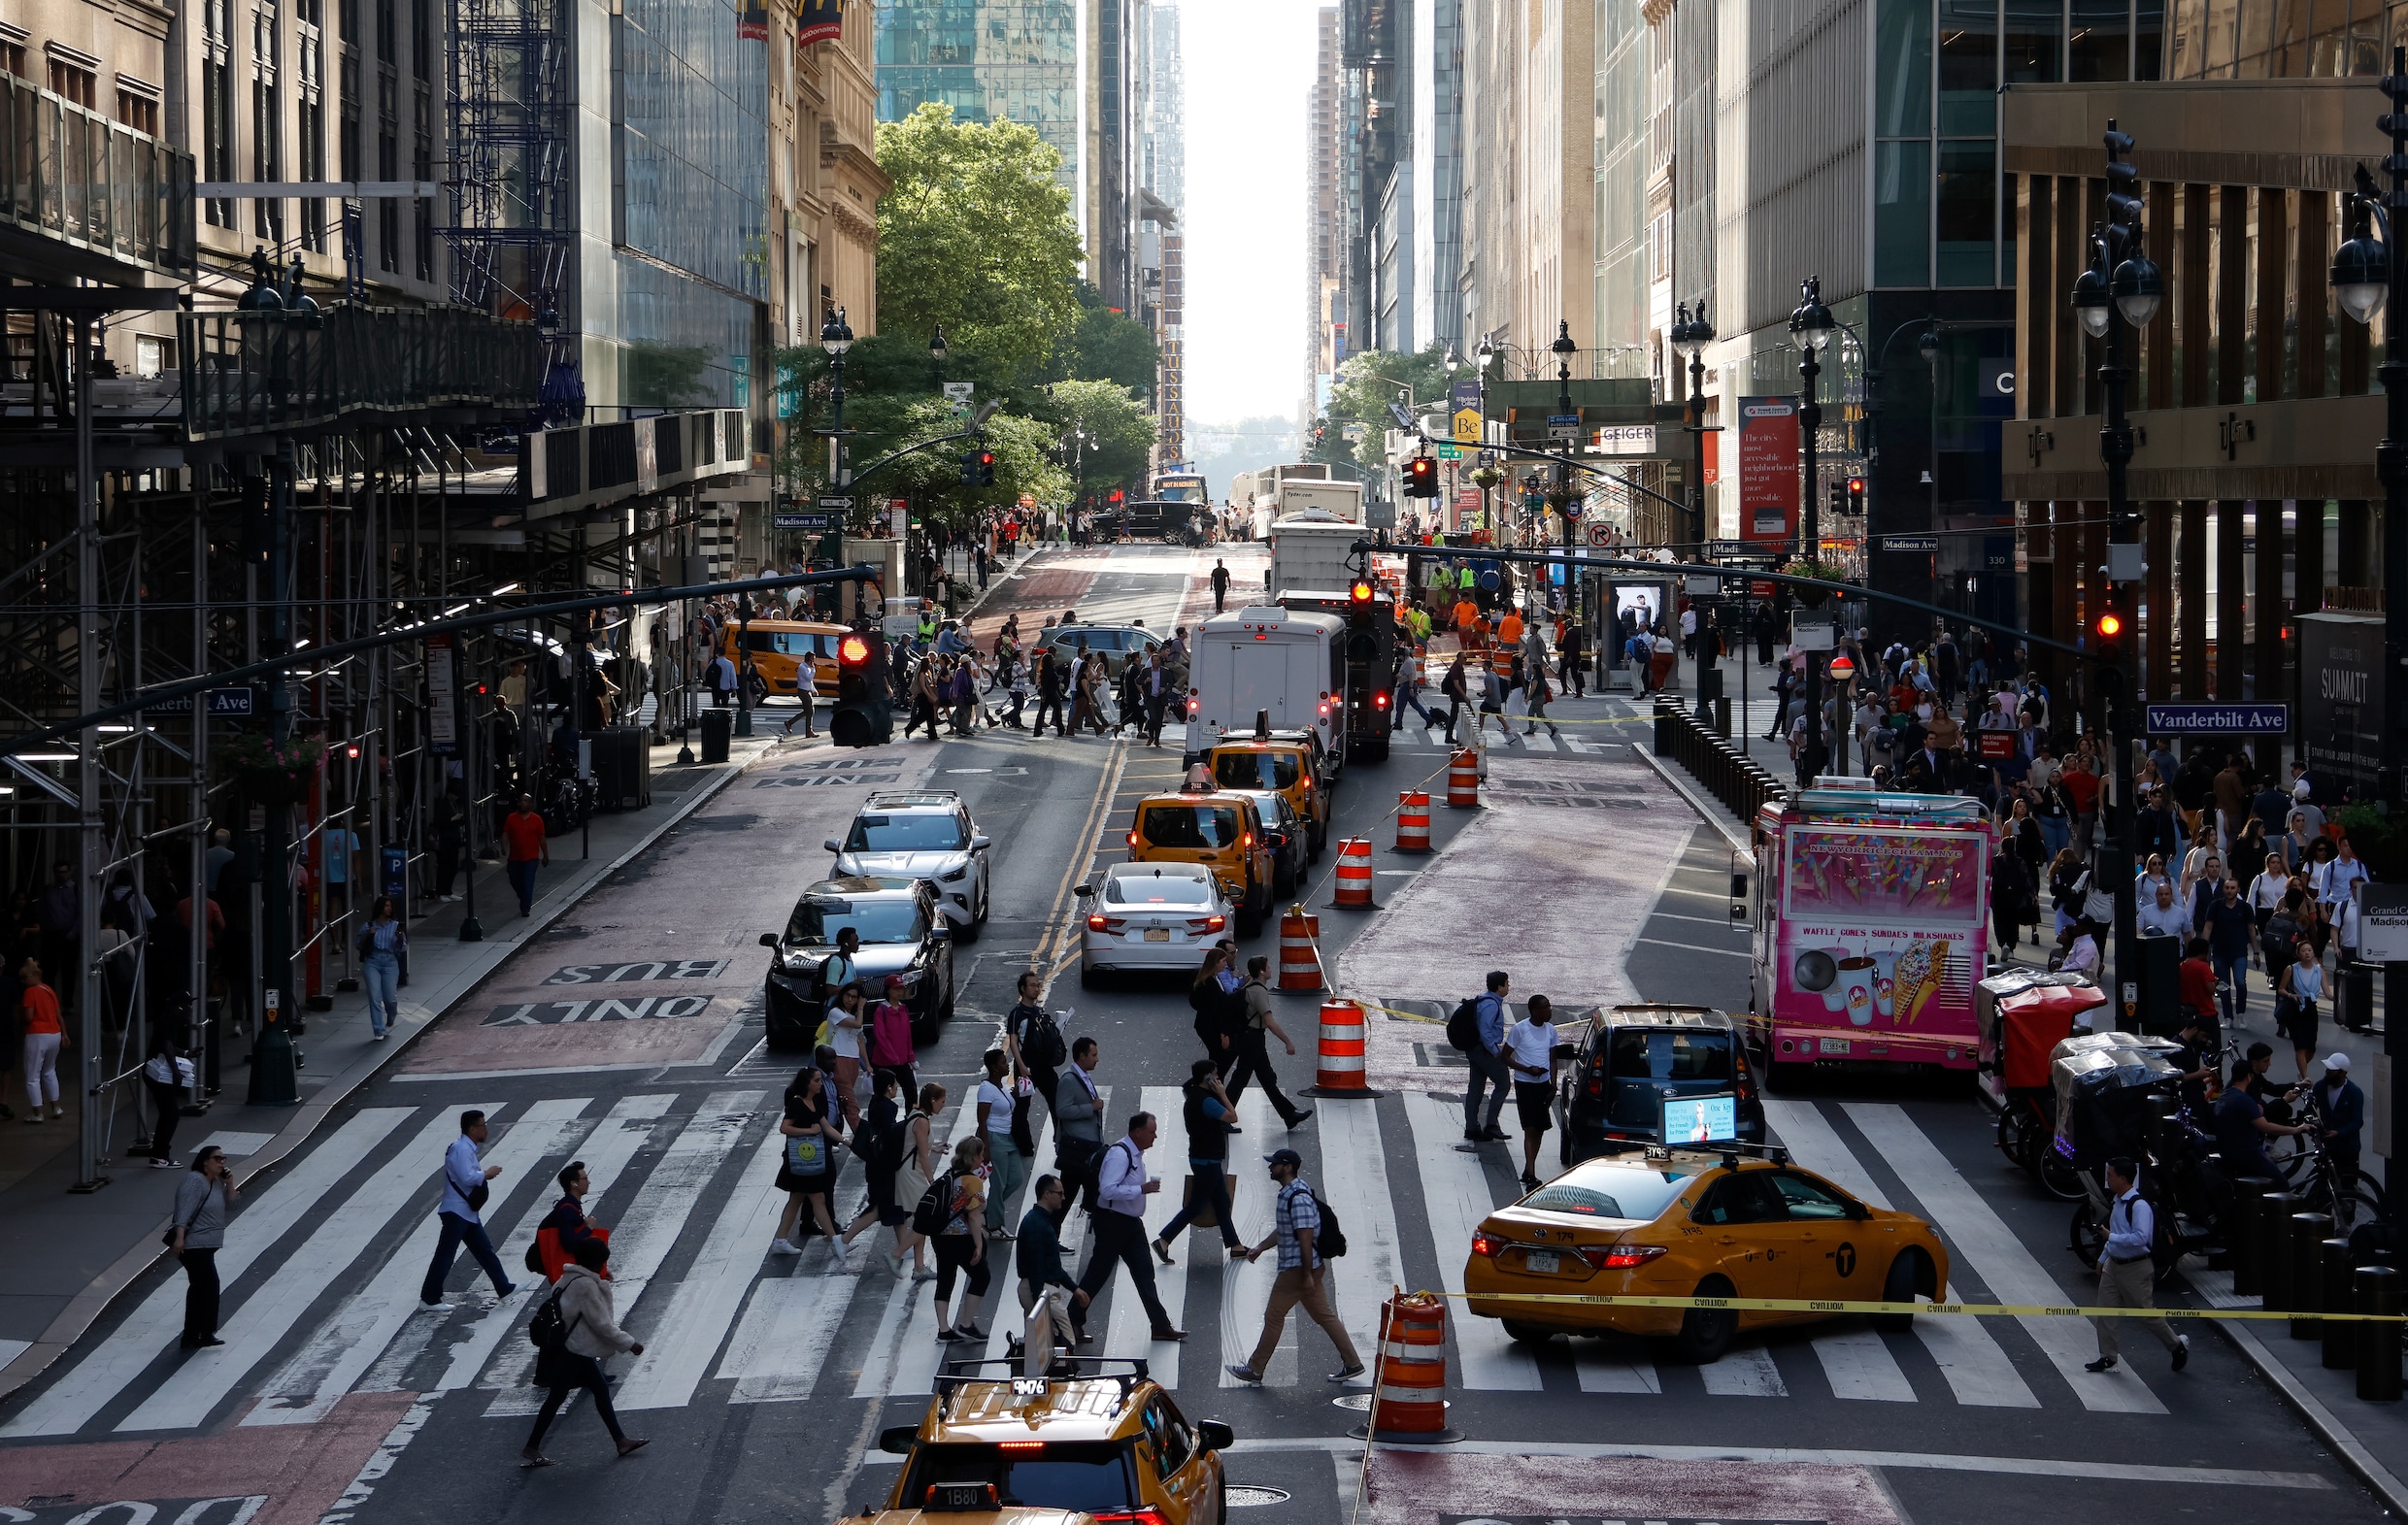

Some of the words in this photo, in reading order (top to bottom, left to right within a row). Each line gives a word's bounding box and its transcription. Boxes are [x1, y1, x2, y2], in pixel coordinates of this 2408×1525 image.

[1168, 342, 1180, 460] TUSSAUDS
[1456, 418, 1477, 434] Be
[1604, 428, 1653, 440] GEIGER
[1745, 433, 1758, 442] The
[1760, 433, 1778, 443] city's
[1744, 453, 1780, 462] accessible
[1744, 463, 1795, 472] neighborhood
[1745, 493, 1783, 502] accessible.
[1714, 544, 1741, 553] Madi
[1885, 540, 1919, 549] Madison
[1921, 540, 1937, 549] Ave
[1989, 556, 2005, 564] 330
[2322, 668, 2368, 704] SUMMIT
[216, 695, 249, 710] Ave
[2151, 712, 2244, 728] Vanderbilt
[2248, 712, 2282, 728] Ave
[1809, 844, 1964, 859] NEWYORKICECREAM.NYC
[392, 859, 401, 872] P
[2370, 906, 2397, 915] Grand
[1803, 928, 1836, 936] WAFFLE
[1840, 929, 1867, 937] CONES
[1871, 930, 1908, 939] SUNDAES
[1913, 931, 1964, 941] MILKSHAKES
[549, 959, 731, 985] BUS
[479, 997, 709, 1027] ONLY
[1723, 1103, 1732, 1113] Key
[1646, 1146, 1666, 1159] 3Y95
[1556, 1231, 1574, 1242] 179
[1681, 1227, 1703, 1235] 3Y95
[1840, 1249, 1851, 1273] T
[1014, 1380, 1045, 1395] 9M76
[946, 1490, 978, 1506] 1B80
